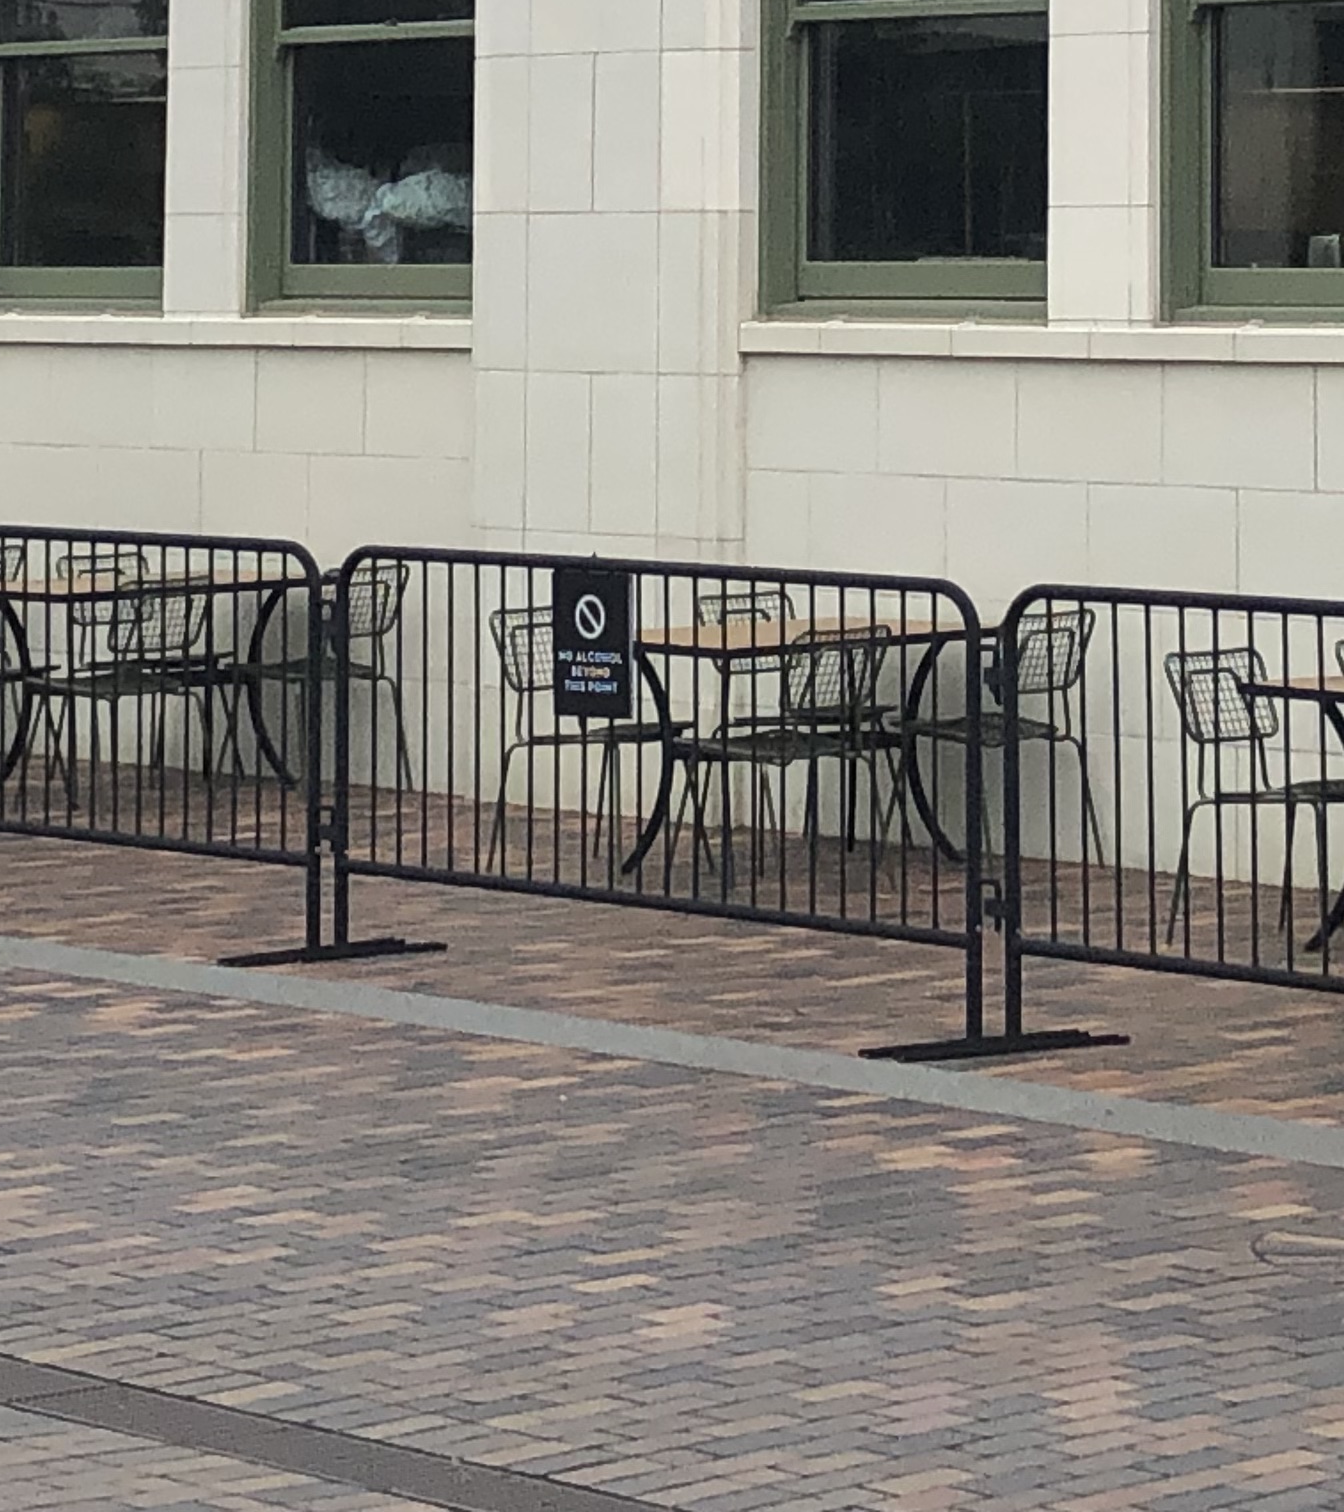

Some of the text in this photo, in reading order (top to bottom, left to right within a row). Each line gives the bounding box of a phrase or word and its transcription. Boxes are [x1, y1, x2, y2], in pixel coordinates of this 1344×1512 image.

[558, 650, 623, 664] NO ALCOHOL
[571, 665, 610, 679] BEYOND
[564, 679, 618, 694] THIS POINT
